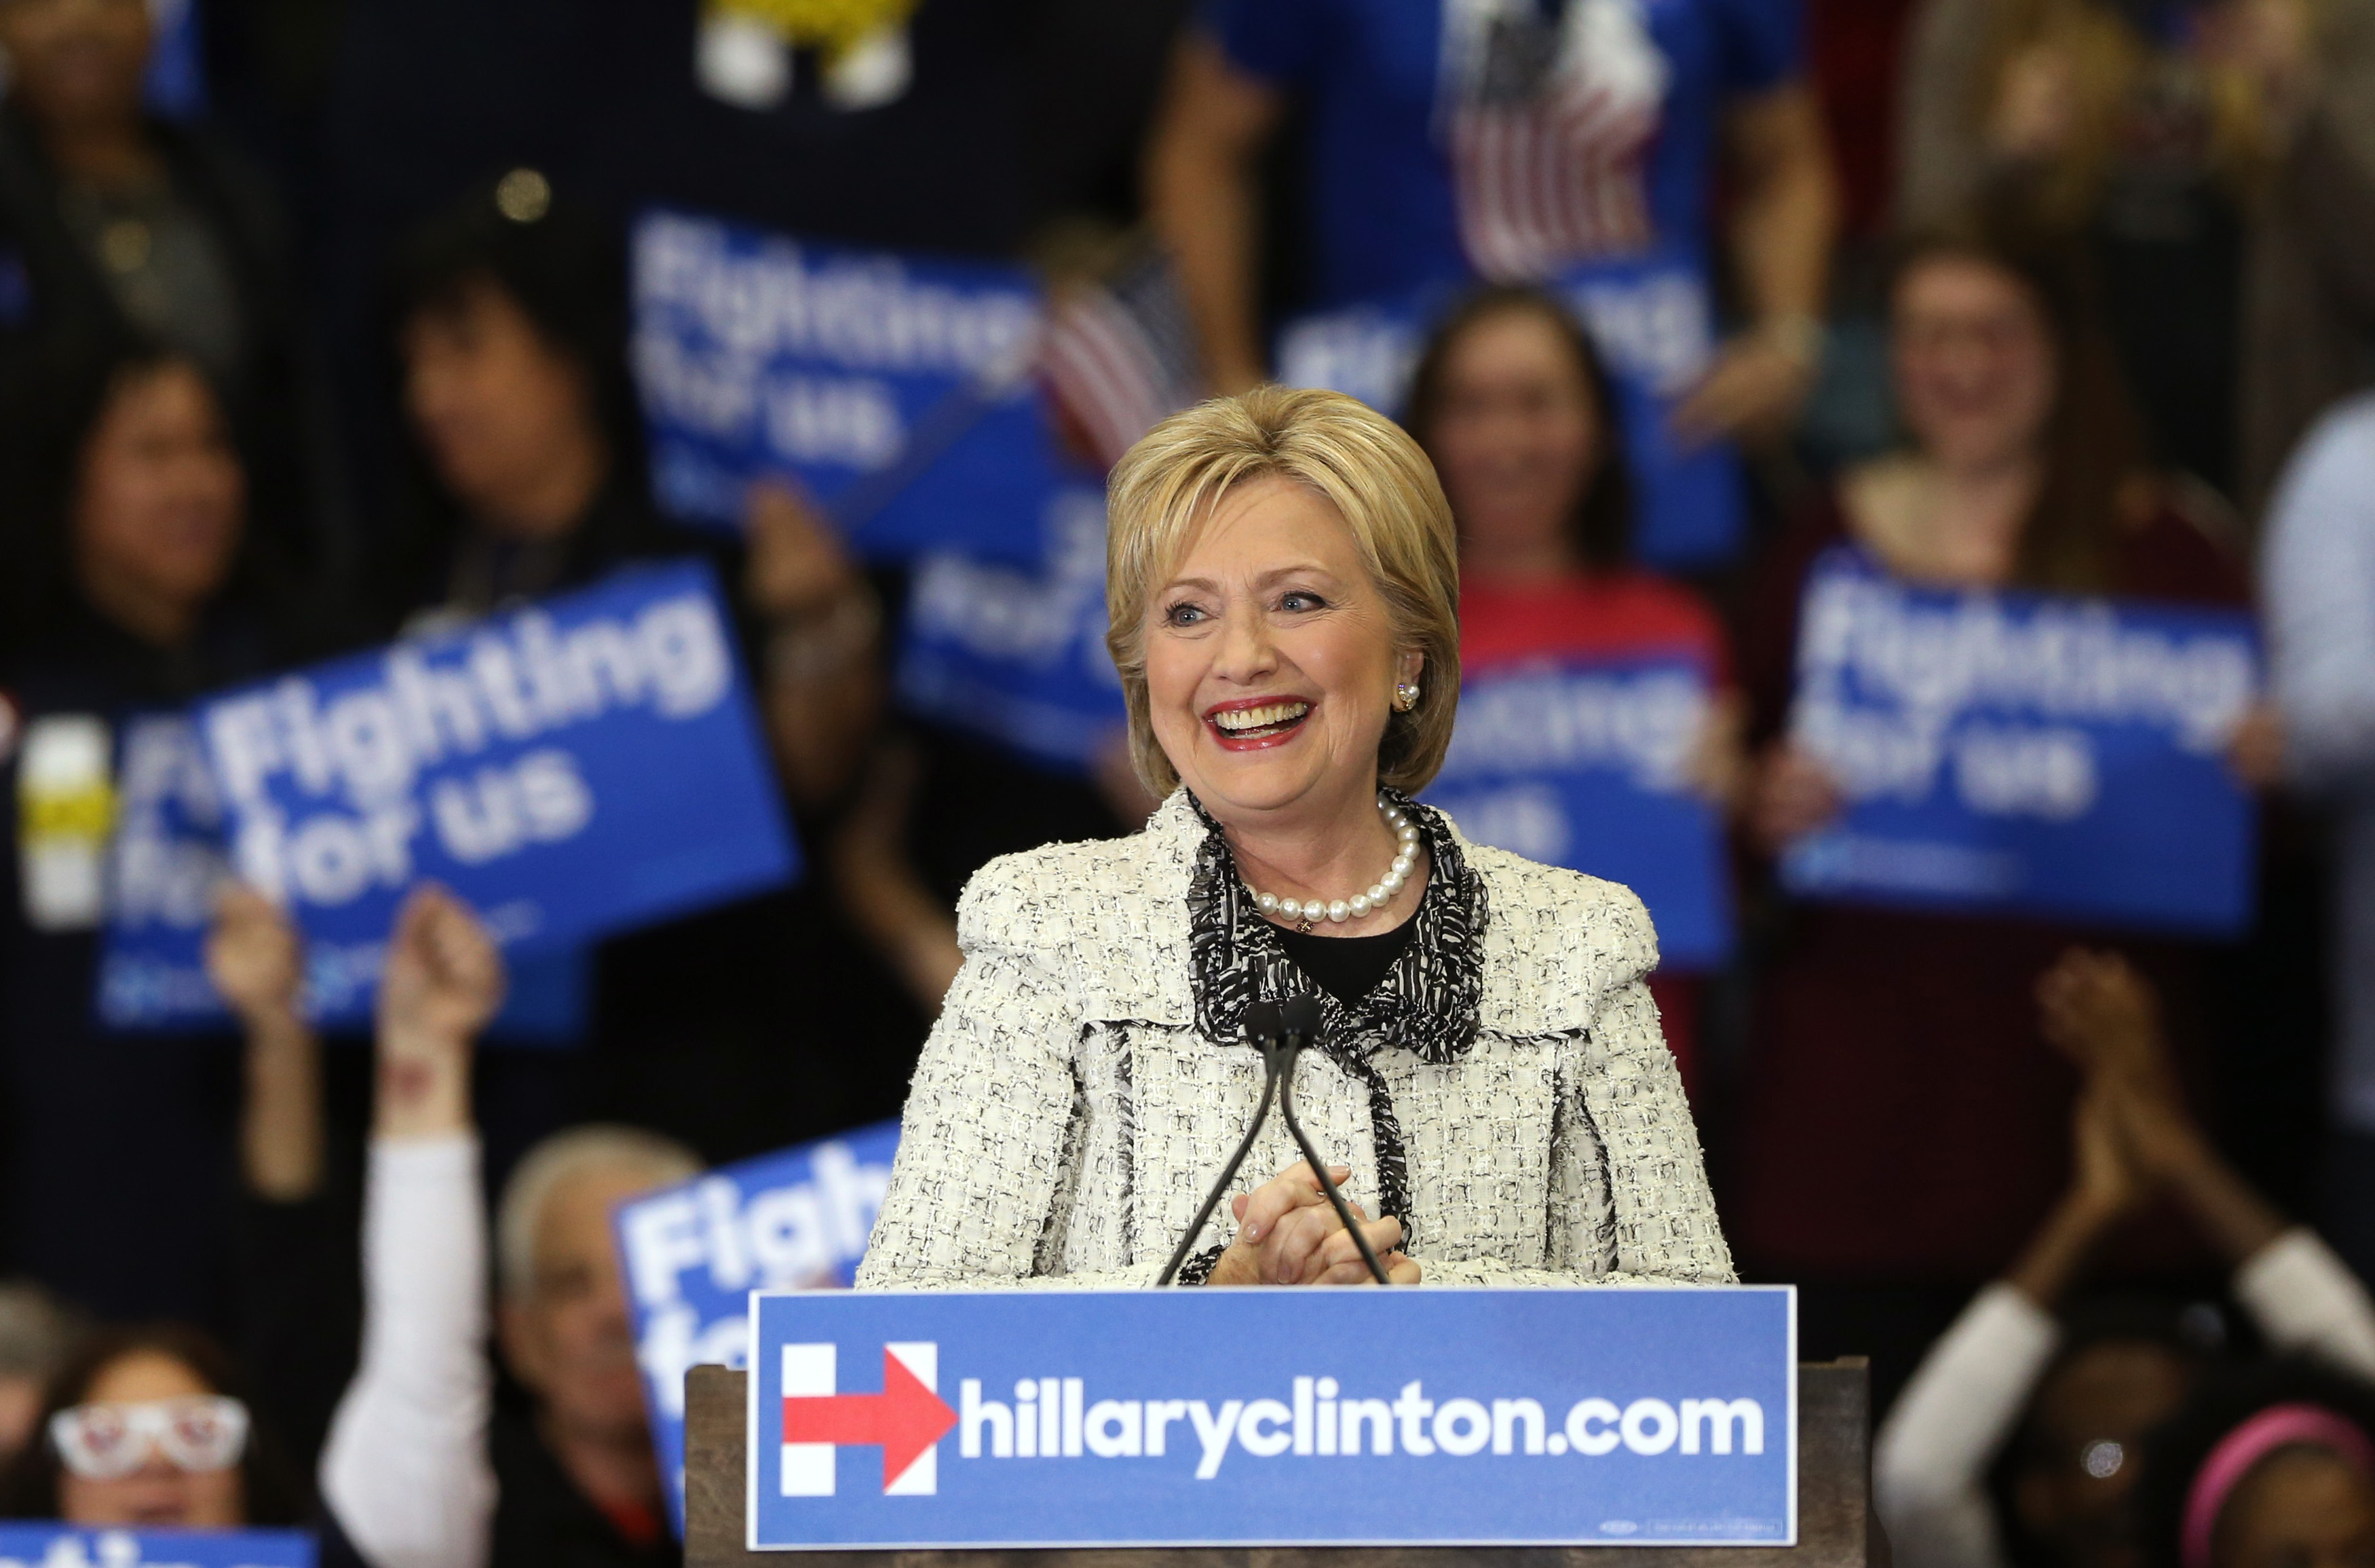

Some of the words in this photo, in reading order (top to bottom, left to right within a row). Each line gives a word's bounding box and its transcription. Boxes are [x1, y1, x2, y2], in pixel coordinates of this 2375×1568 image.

[206, 593, 733, 810] Fighting
[1800, 570, 2252, 756] Fighting
[236, 802, 422, 906] for
[429, 748, 594, 864] us
[1954, 727, 2098, 823] us
[962, 1378, 1763, 1478] hillaryclinton.com
